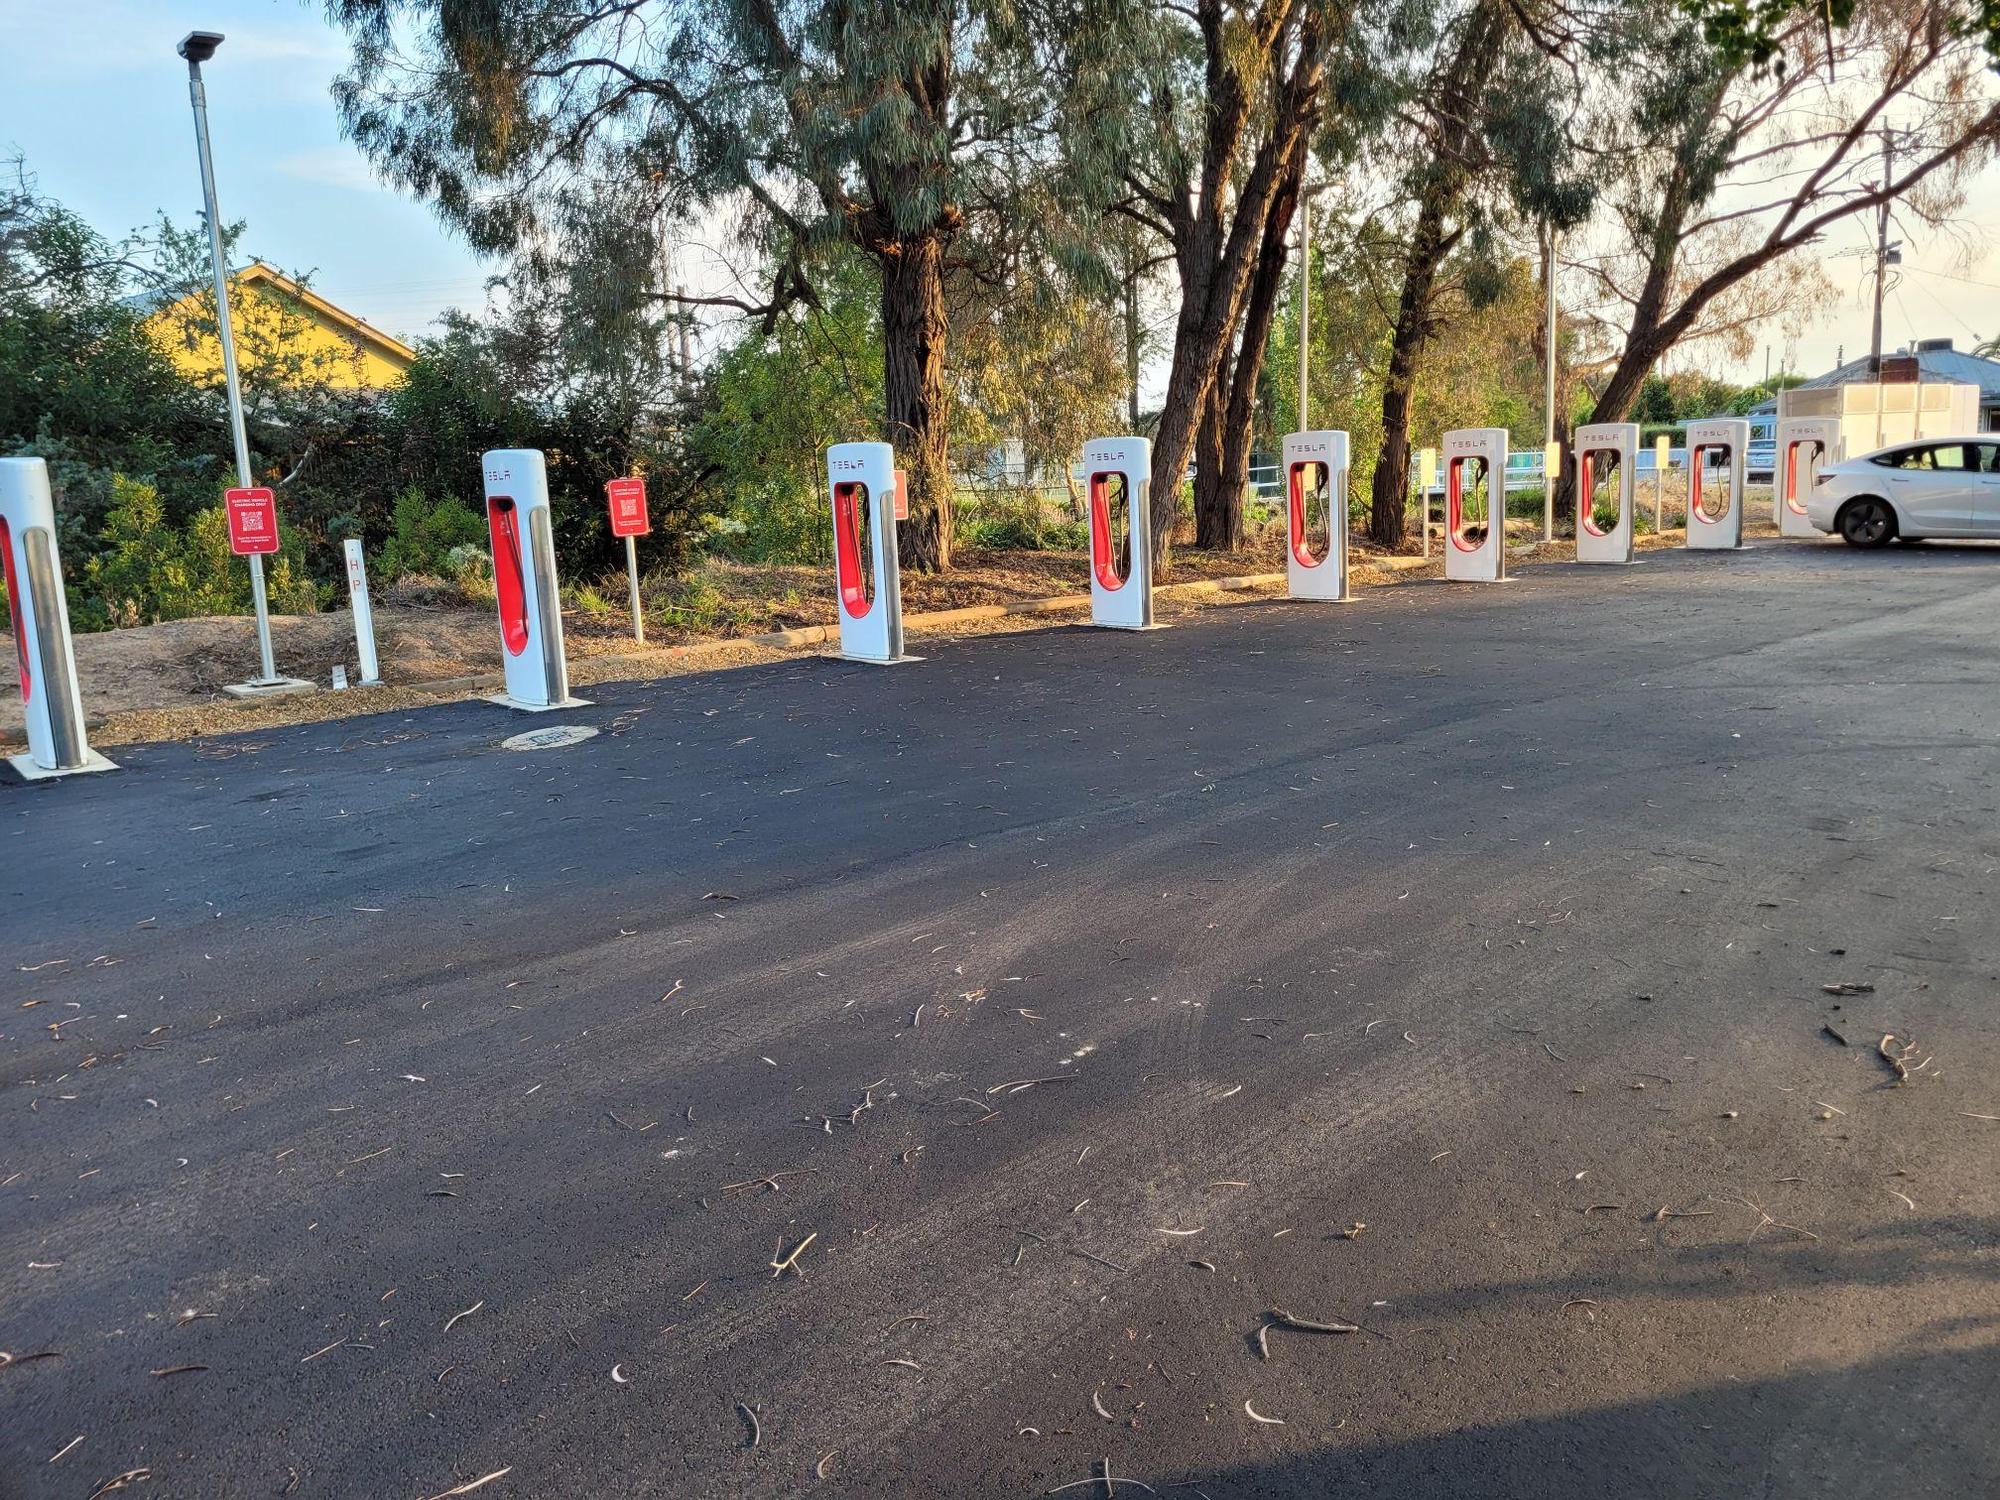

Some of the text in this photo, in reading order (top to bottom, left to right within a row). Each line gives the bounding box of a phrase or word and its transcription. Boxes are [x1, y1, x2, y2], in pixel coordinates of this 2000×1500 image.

[1290, 443, 1326, 452] TESLA
[1451, 440, 1487, 448] TESLA
[1091, 451, 1125, 461] TESLA
[832, 460, 864, 470] TESLA
